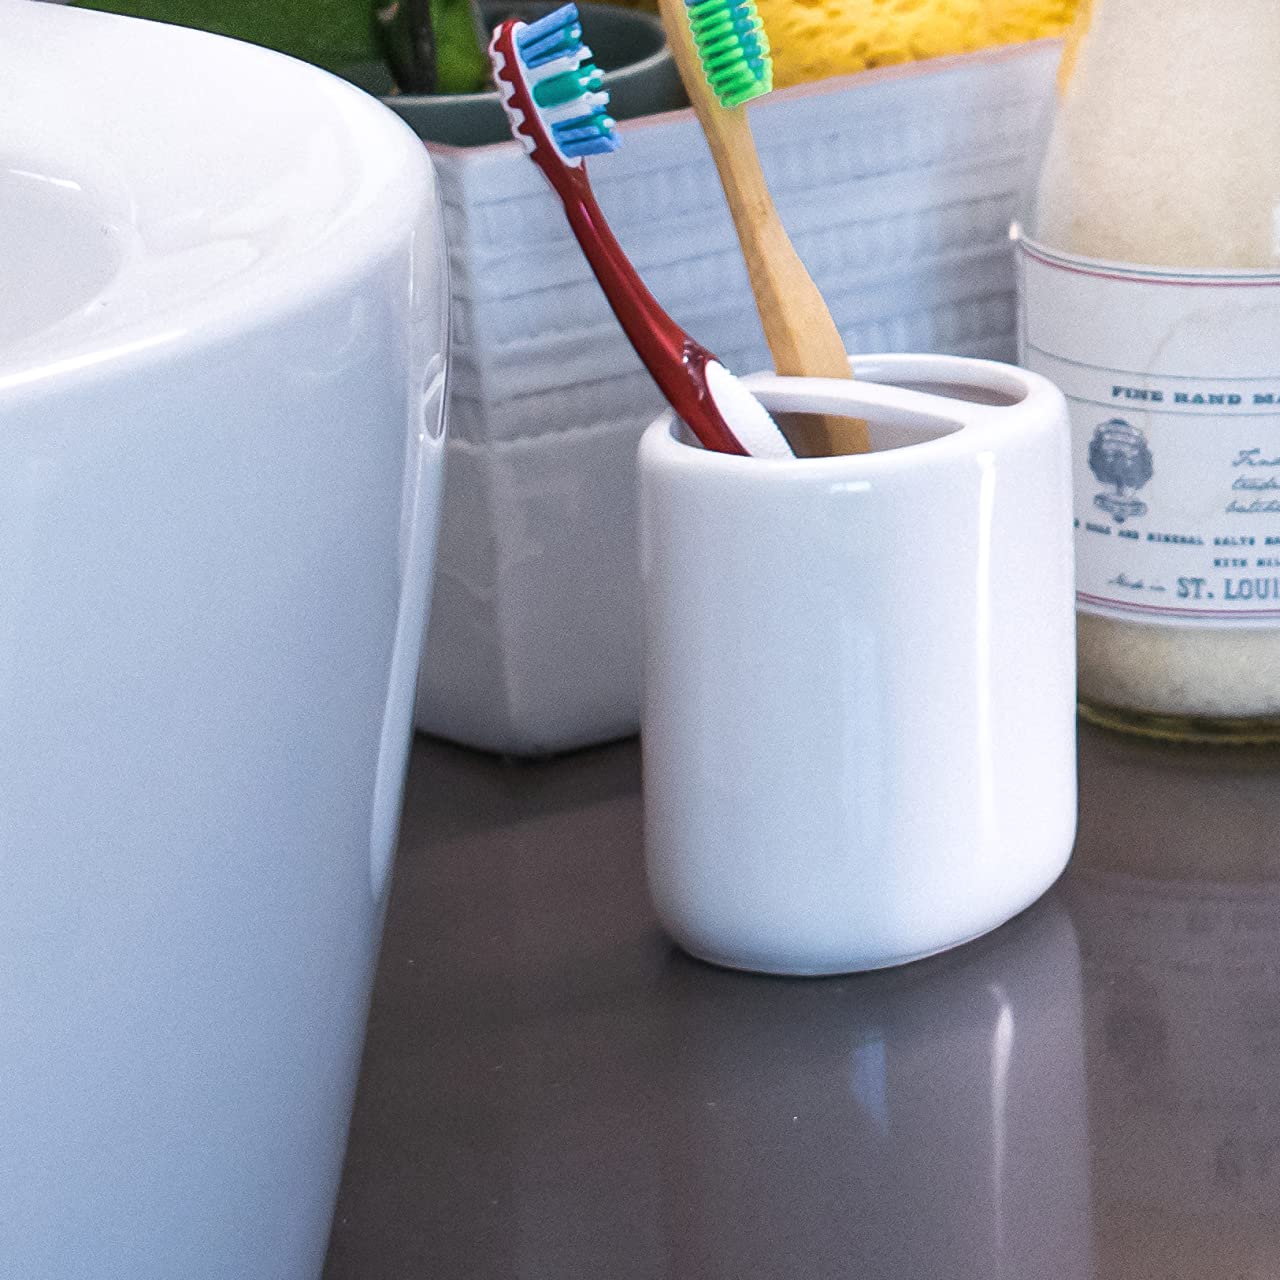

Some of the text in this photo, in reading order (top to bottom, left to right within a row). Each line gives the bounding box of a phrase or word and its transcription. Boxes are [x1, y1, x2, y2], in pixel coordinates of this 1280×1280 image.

[1112, 385, 1164, 402] FINE
[1174, 391, 1242, 405] HAND
[1177, 576, 1215, 599] ST.
